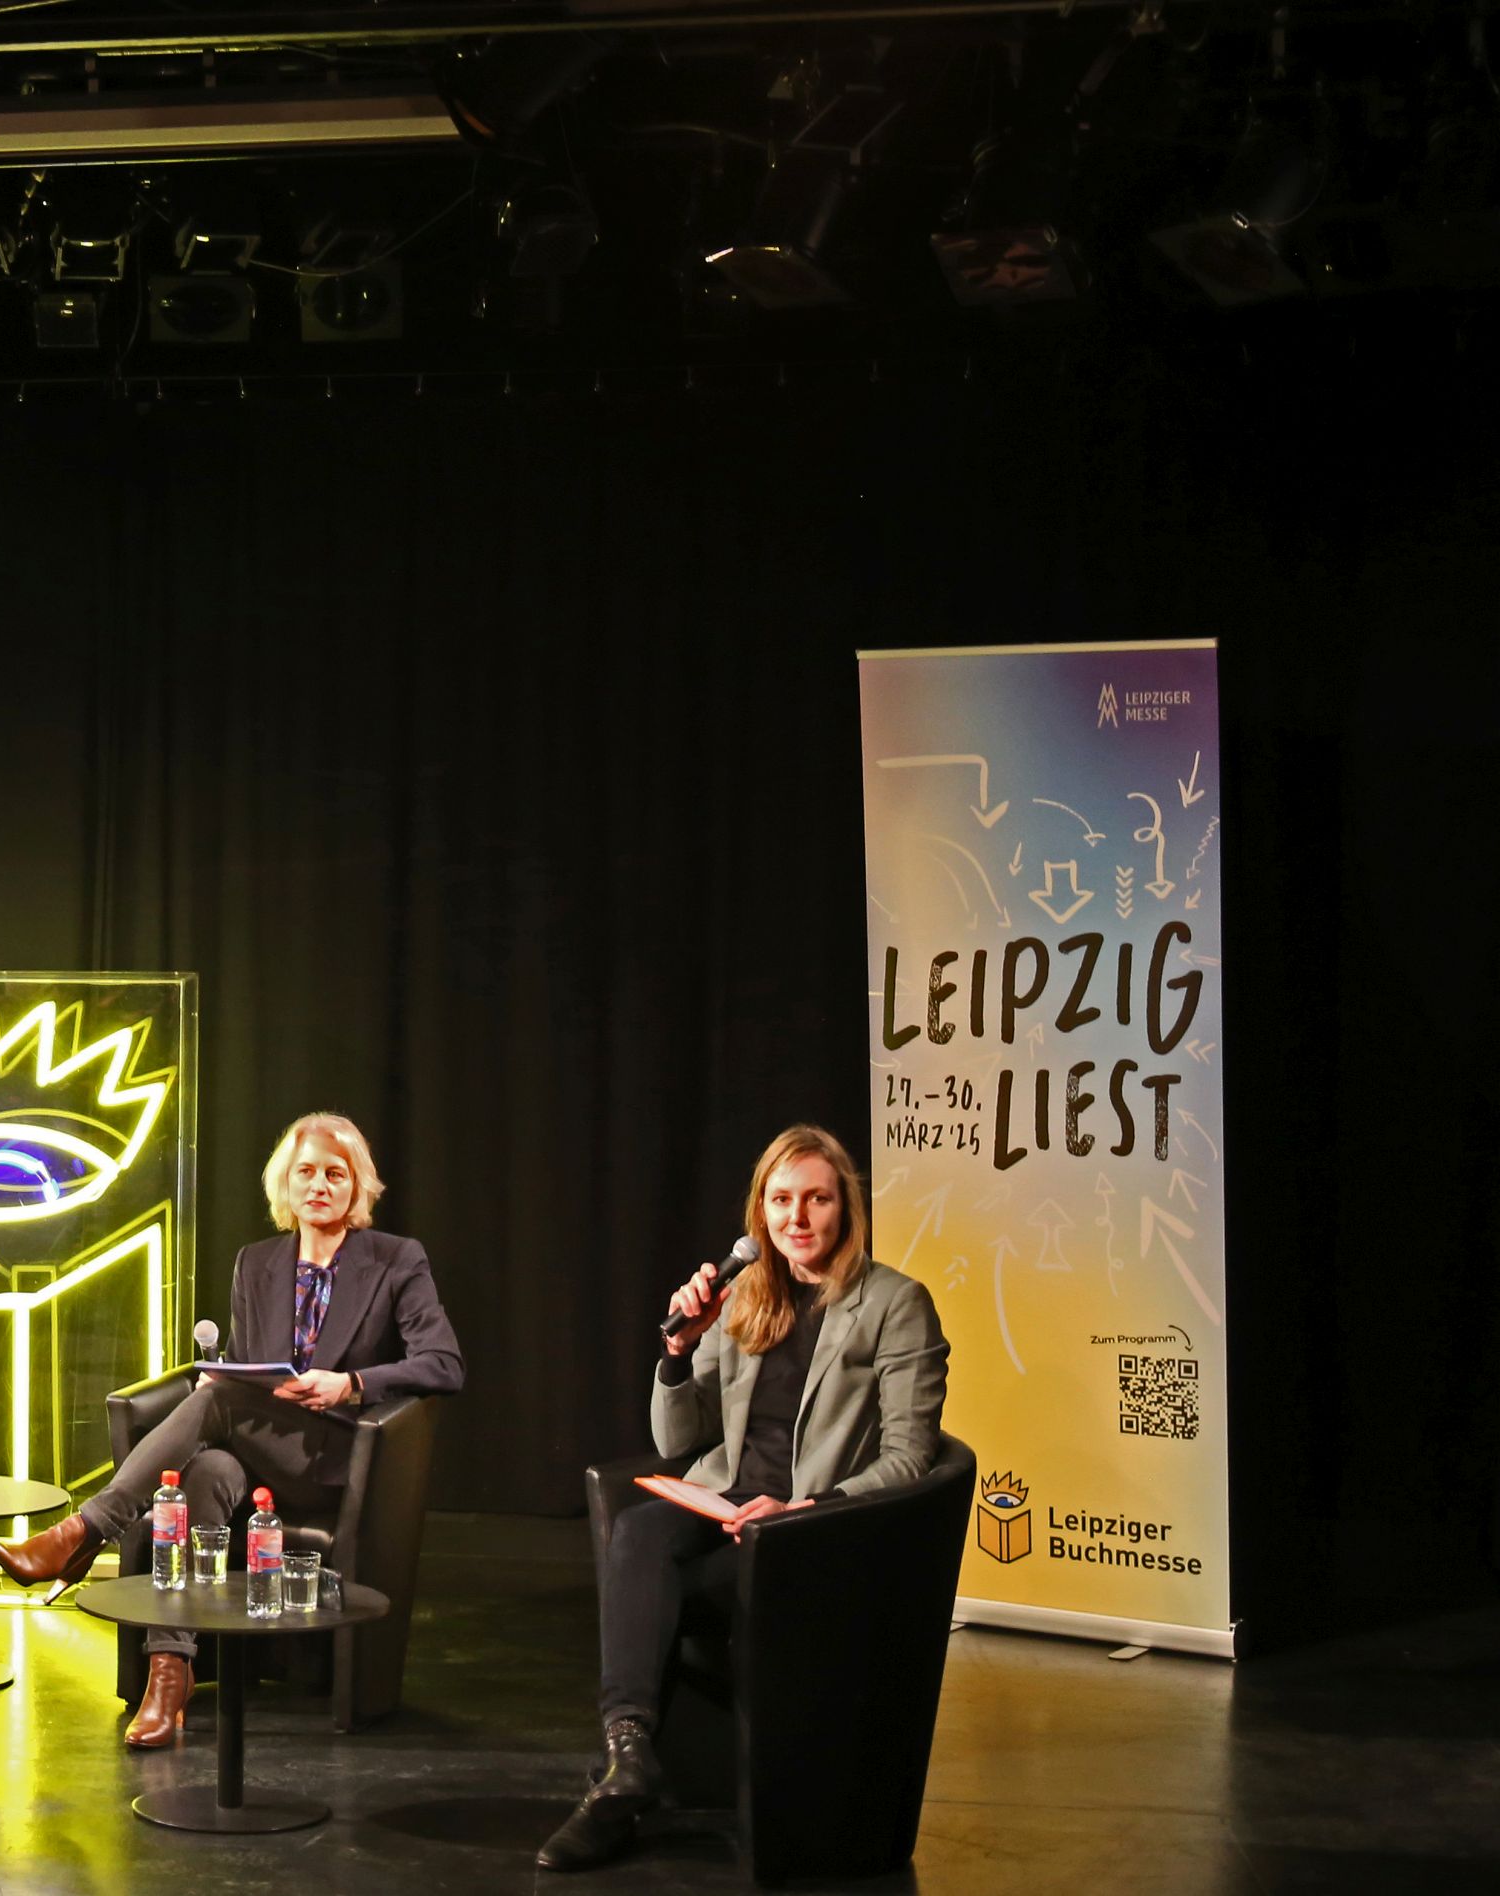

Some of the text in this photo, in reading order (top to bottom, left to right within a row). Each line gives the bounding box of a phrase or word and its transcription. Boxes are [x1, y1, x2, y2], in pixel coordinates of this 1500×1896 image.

[1124, 690, 1190, 705] LEIPZIGER
[1125, 708, 1168, 722] MESSE
[882, 921, 1204, 1056] LEIPZIG
[993, 1059, 1183, 1171] LIEST
[886, 1116, 981, 1154] MÄRZ '25
[1090, 1334, 1177, 1345] Zum Programm
[1049, 1507, 1172, 1543] Leipziger
[1049, 1536, 1202, 1575] Buchmesse
